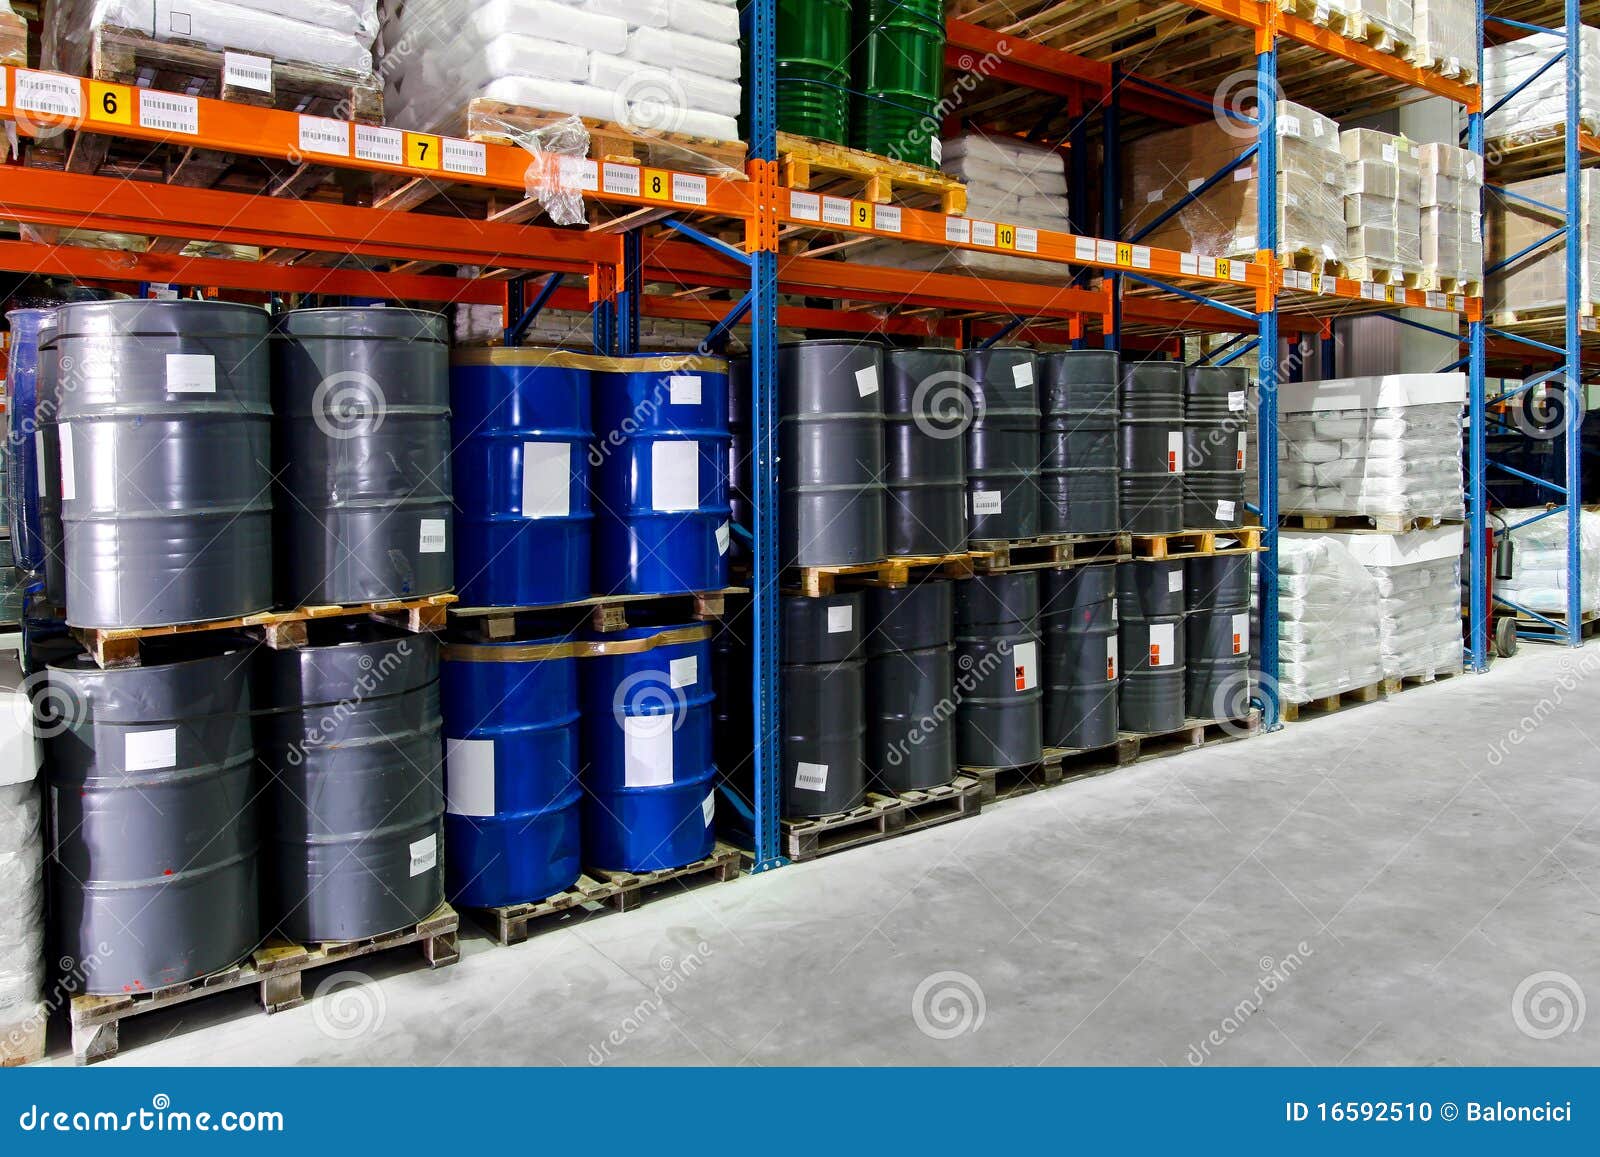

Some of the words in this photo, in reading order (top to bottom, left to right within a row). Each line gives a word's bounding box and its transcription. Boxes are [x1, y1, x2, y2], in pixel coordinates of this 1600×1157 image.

[103, 92, 117, 115] 6
[417, 142, 429, 161] 7
[652, 176, 661, 193] 8
[859, 207, 866, 222] 9
[1000, 230, 1012, 244] 10
[1121, 248, 1129, 261] 11
[1219, 263, 1227, 275] 12
